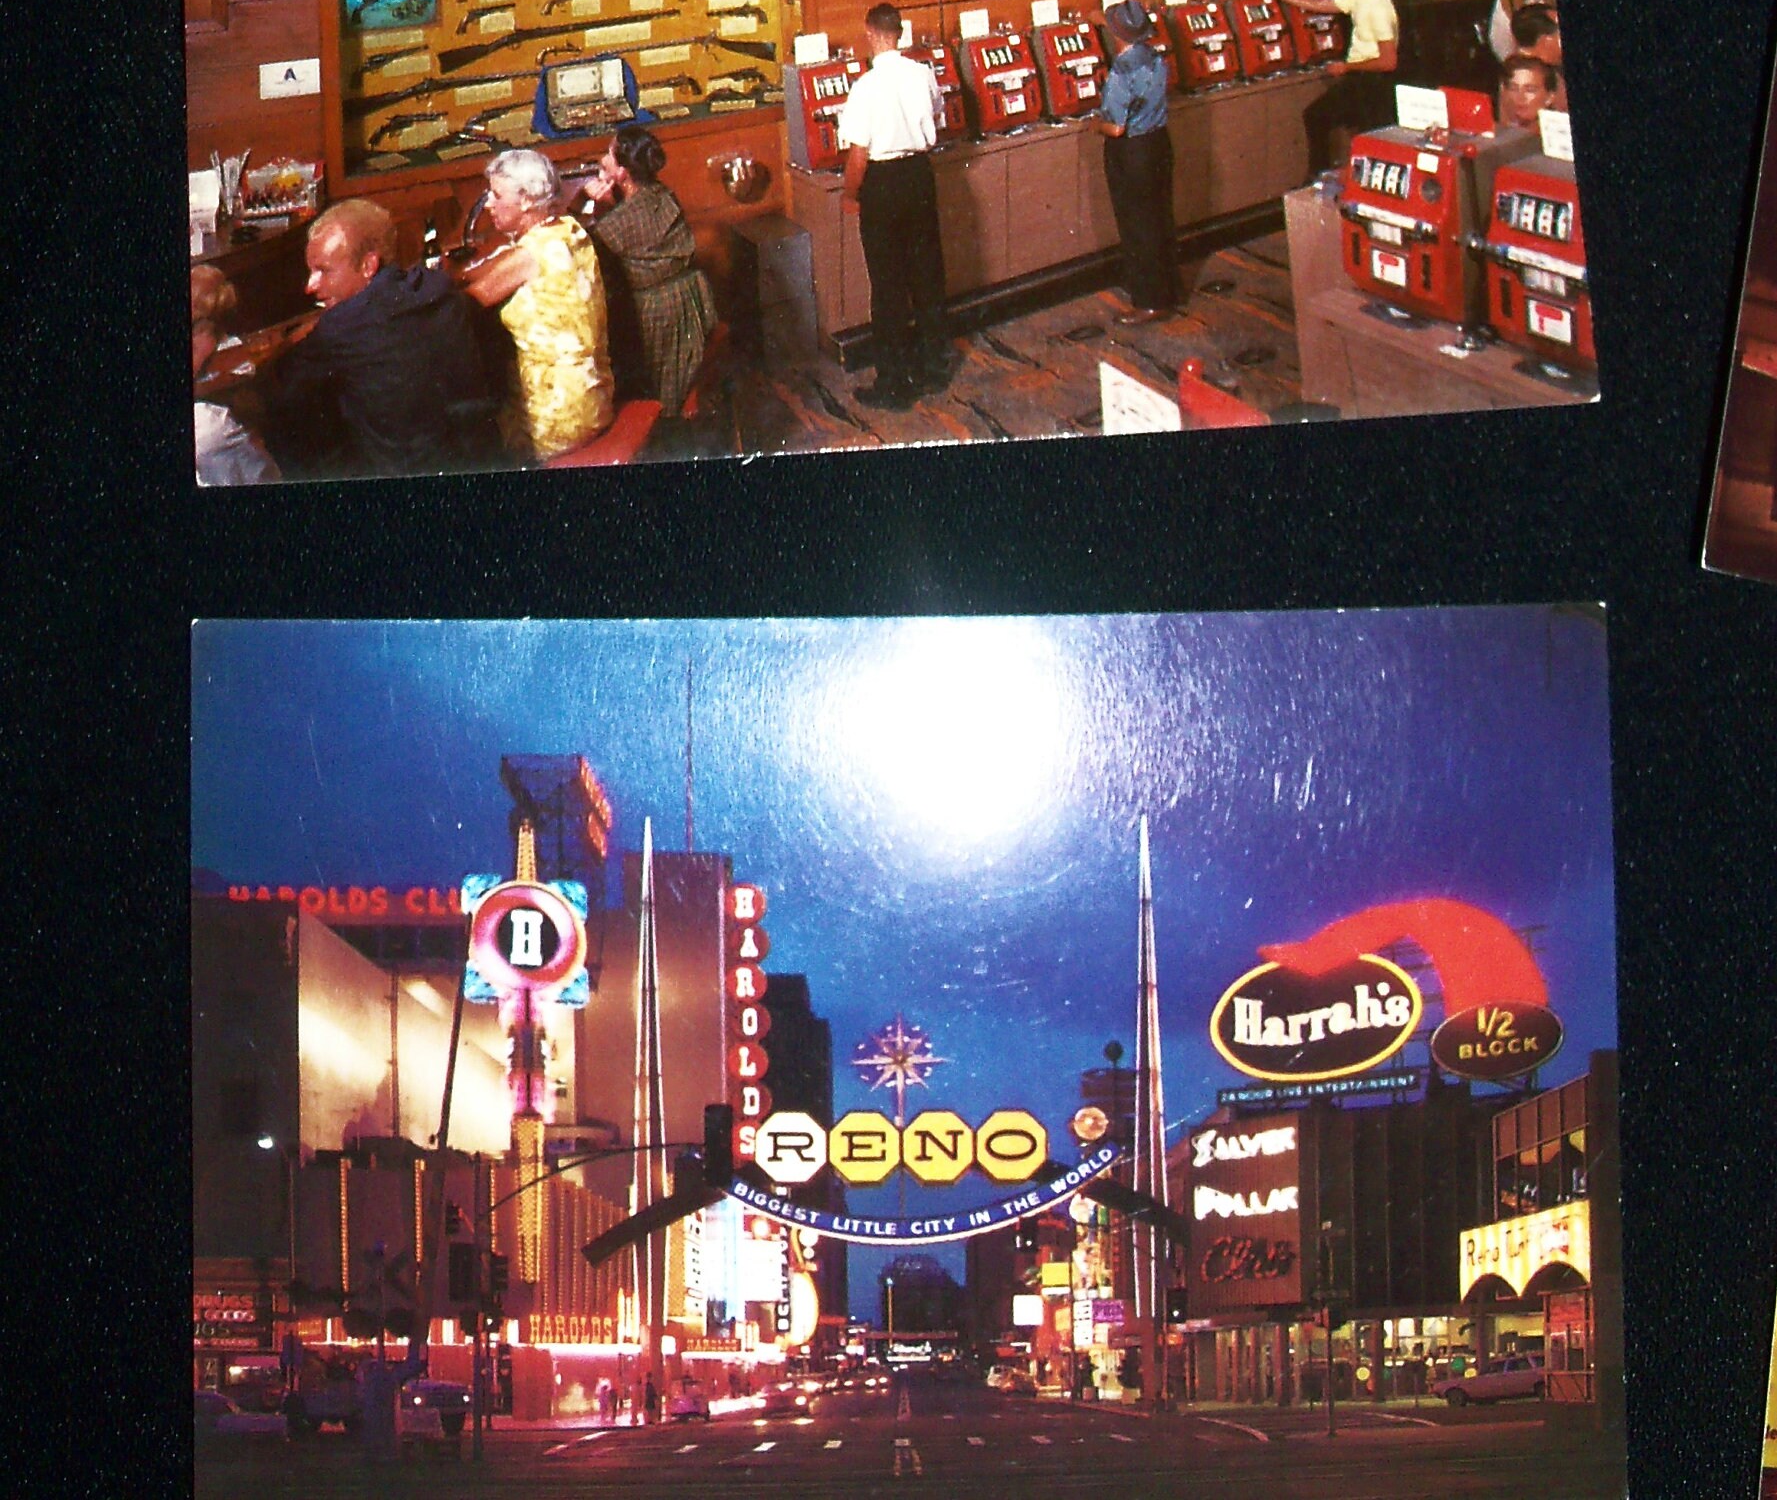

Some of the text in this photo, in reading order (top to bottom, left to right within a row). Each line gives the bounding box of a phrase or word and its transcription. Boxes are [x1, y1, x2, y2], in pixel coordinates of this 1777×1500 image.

[284, 67, 297, 81] A
[510, 907, 544, 967] H
[734, 885, 760, 1156] HAROLDS
[1232, 980, 1411, 1047] Harrah's
[1476, 1006, 1518, 1040] 1/2
[1458, 1036, 1540, 1061] BLOCK
[766, 1128, 1038, 1163] RENO
[1191, 1126, 1297, 1168] SILVER
[734, 1146, 1115, 1236] BIGGEST LITTLE CITY IN THE WORLD
[1193, 1184, 1299, 1221] DOLLAR
[529, 1314, 613, 1344] HAROLDS
